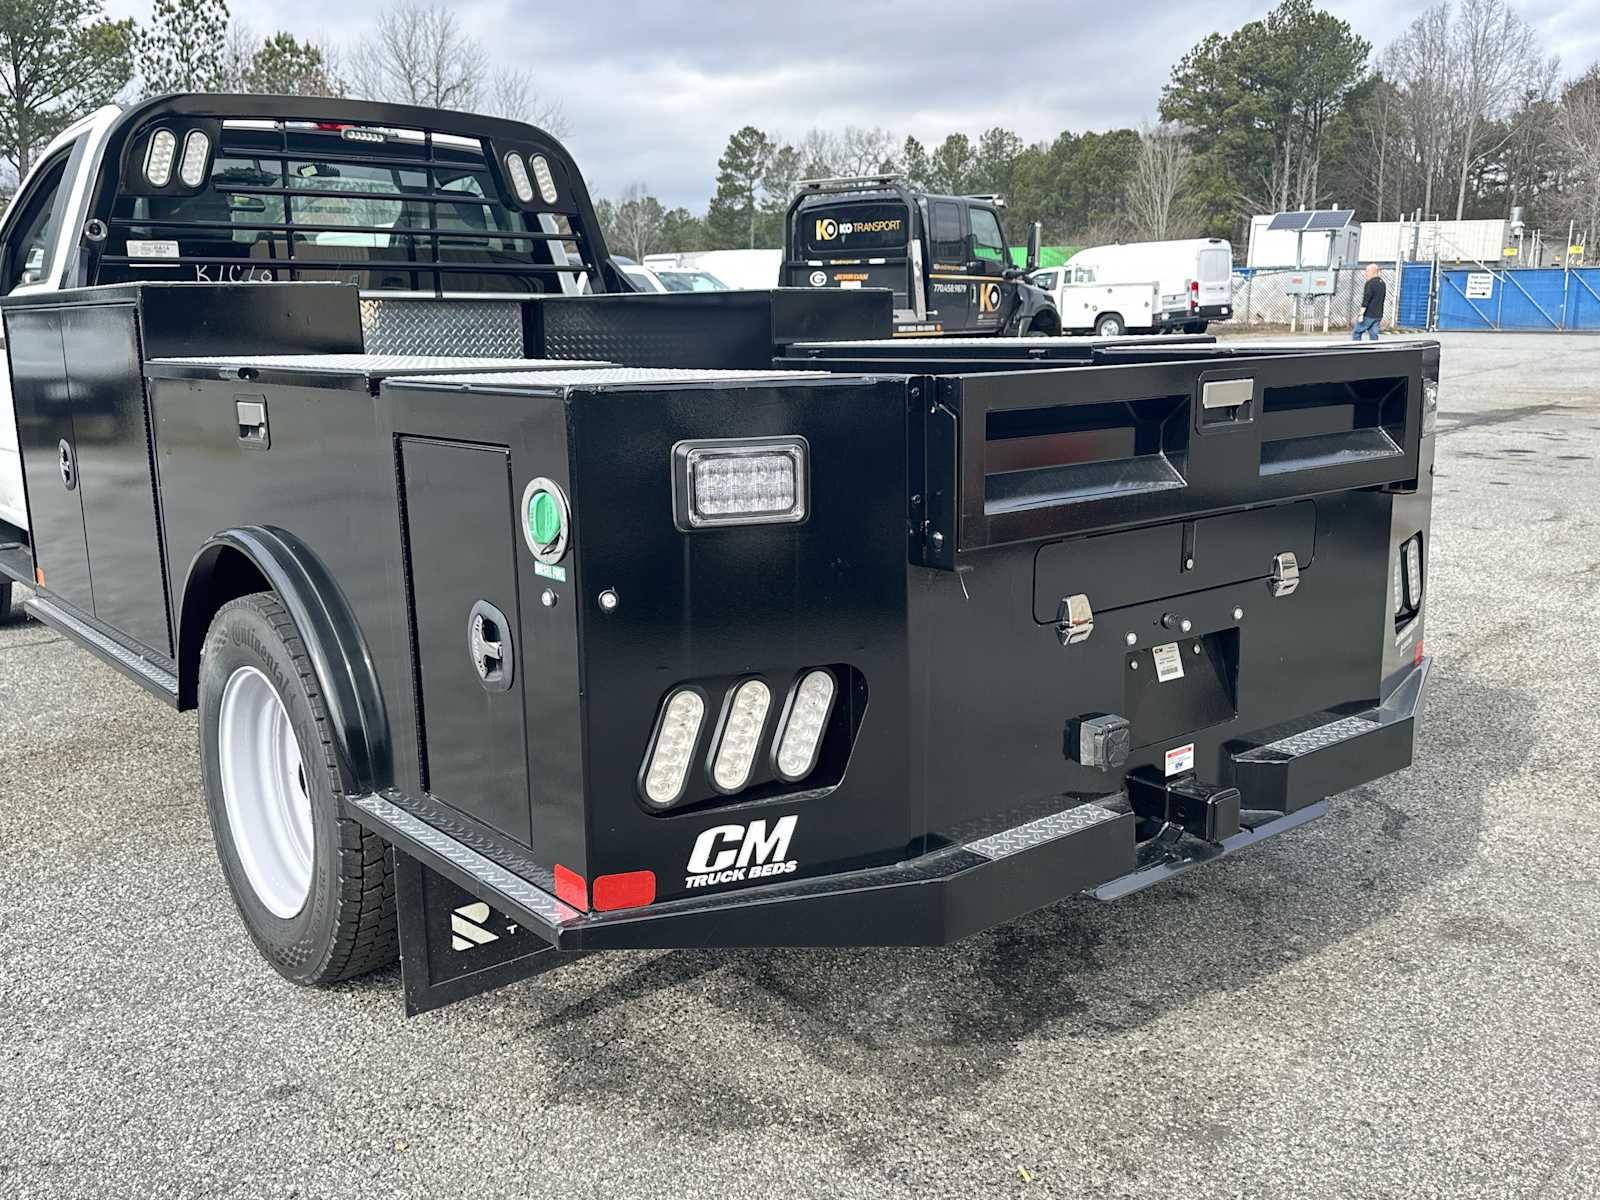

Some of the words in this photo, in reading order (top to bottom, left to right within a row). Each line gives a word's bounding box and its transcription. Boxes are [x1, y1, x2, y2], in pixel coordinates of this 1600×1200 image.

[839, 222, 853, 235] KO
[853, 219, 902, 233] TRANSPORT
[686, 814, 799, 874] CM
[684, 867, 748, 889] TRUCK
[747, 859, 798, 879] BEDS
